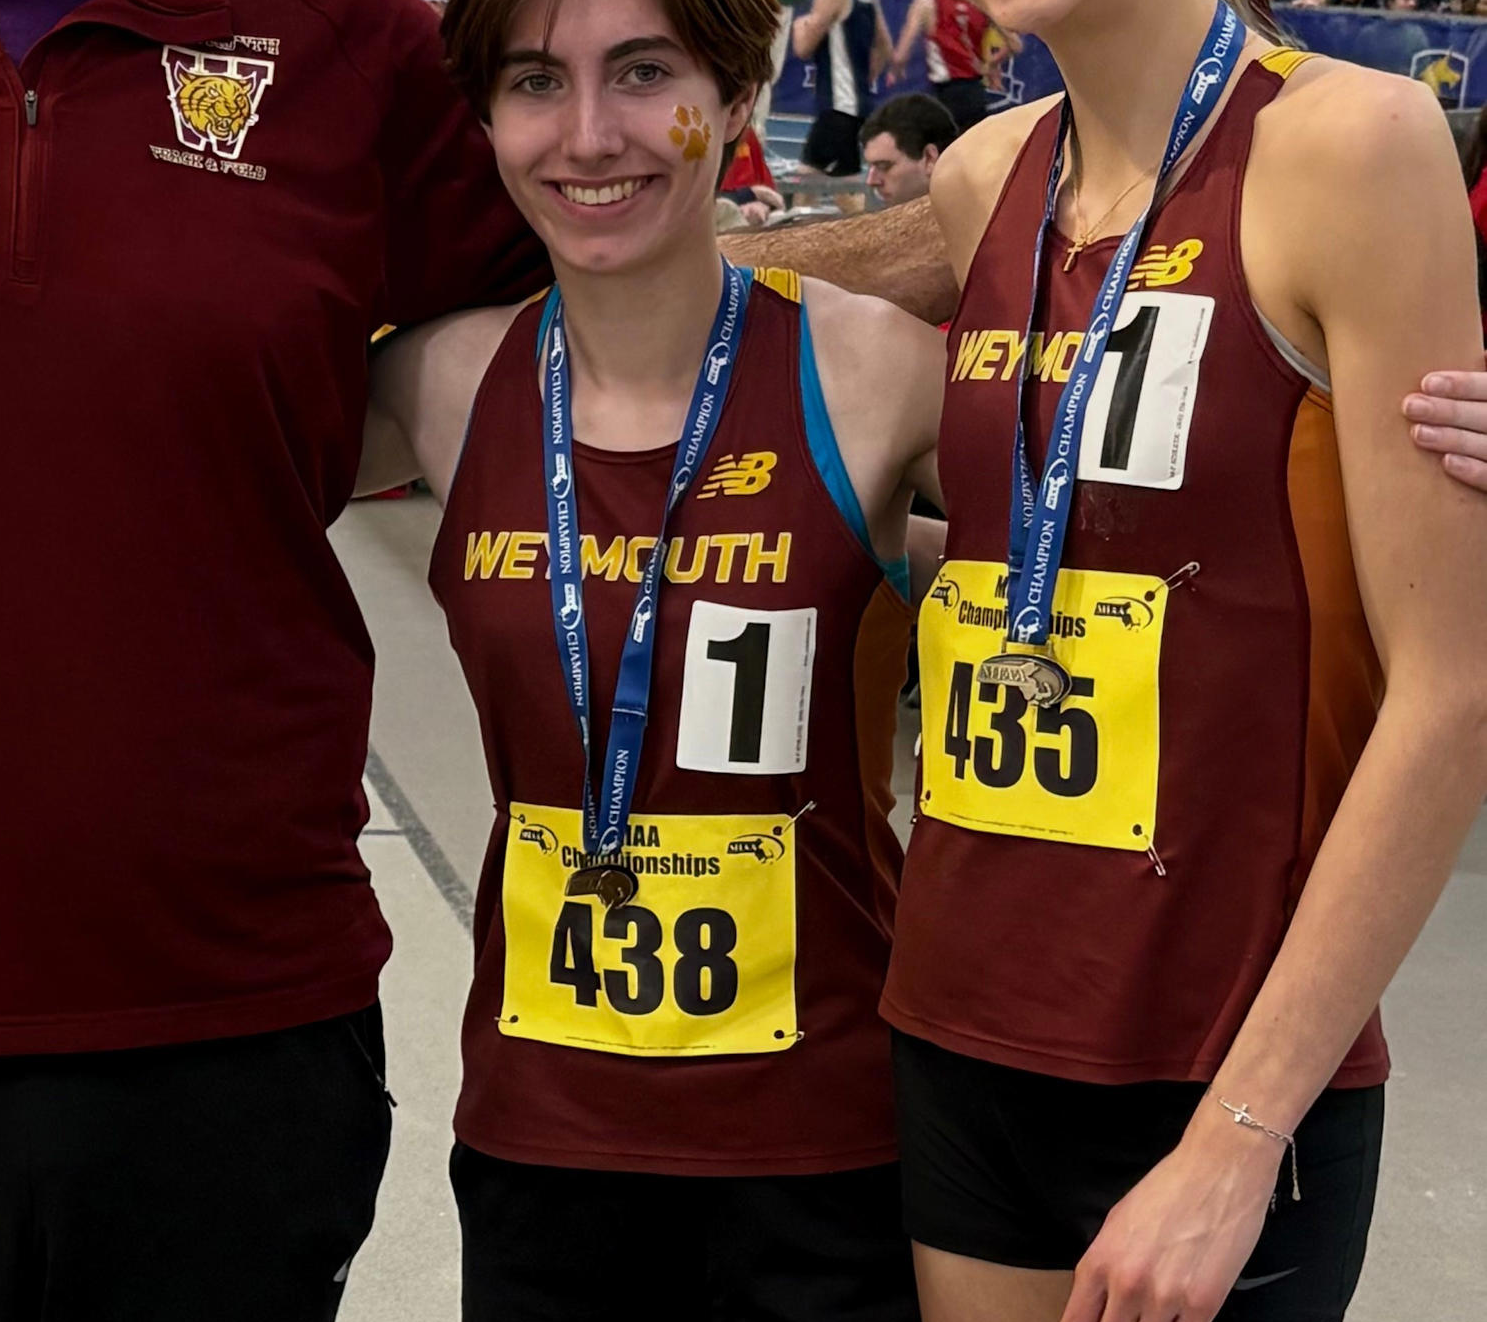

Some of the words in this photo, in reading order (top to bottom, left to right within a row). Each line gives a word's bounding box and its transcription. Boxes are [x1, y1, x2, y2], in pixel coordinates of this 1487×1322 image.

[149, 144, 204, 169] TRACK
[220, 160, 267, 181] FIELD
[1102, 231, 1137, 310] CHAMPION
[551, 372, 564, 445] CHAMPION
[1058, 373, 1088, 456] CHAMPION
[1100, 305, 1161, 470] 1
[685, 393, 714, 466] CHAMPION
[557, 501, 573, 574] CHAMPION
[1028, 520, 1055, 604] CHAMPION
[566, 631, 584, 707] CHAMPION
[707, 622, 771, 763] 1
[944, 661, 1099, 798] 435
[609, 750, 630, 825] CHAMPION
[624, 824, 661, 847] IAA
[550, 901, 739, 1016] 438
